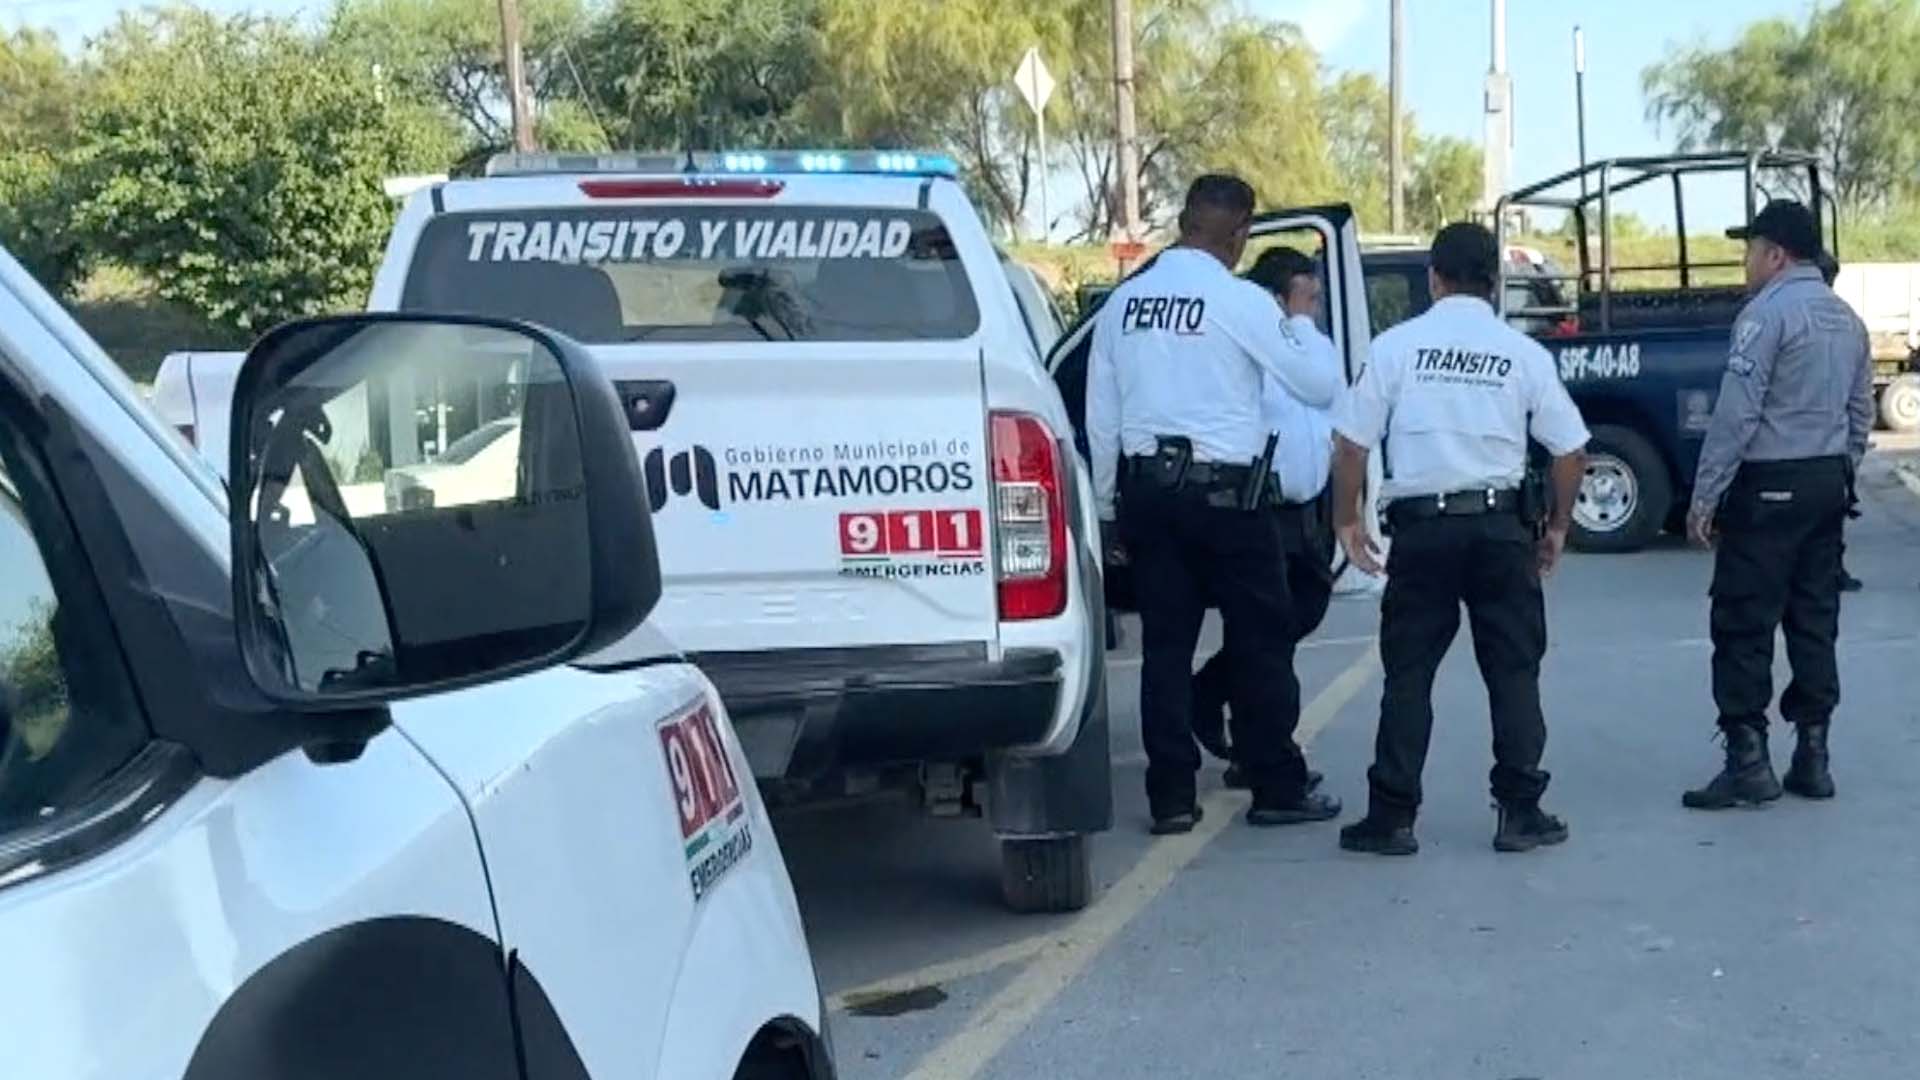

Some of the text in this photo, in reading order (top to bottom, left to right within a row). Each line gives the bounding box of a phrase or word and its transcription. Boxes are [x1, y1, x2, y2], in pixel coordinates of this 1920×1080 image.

[467, 218, 912, 262] TRANSITO Y VIALIDAD
[1122, 296, 1206, 331] PERITO
[1559, 343, 1641, 382] SPF-40-A8
[725, 438, 970, 466] Gobierno Municipal de
[728, 461, 974, 502] MATAMOROS
[846, 512, 969, 552] 911
[667, 712, 734, 821] 911
